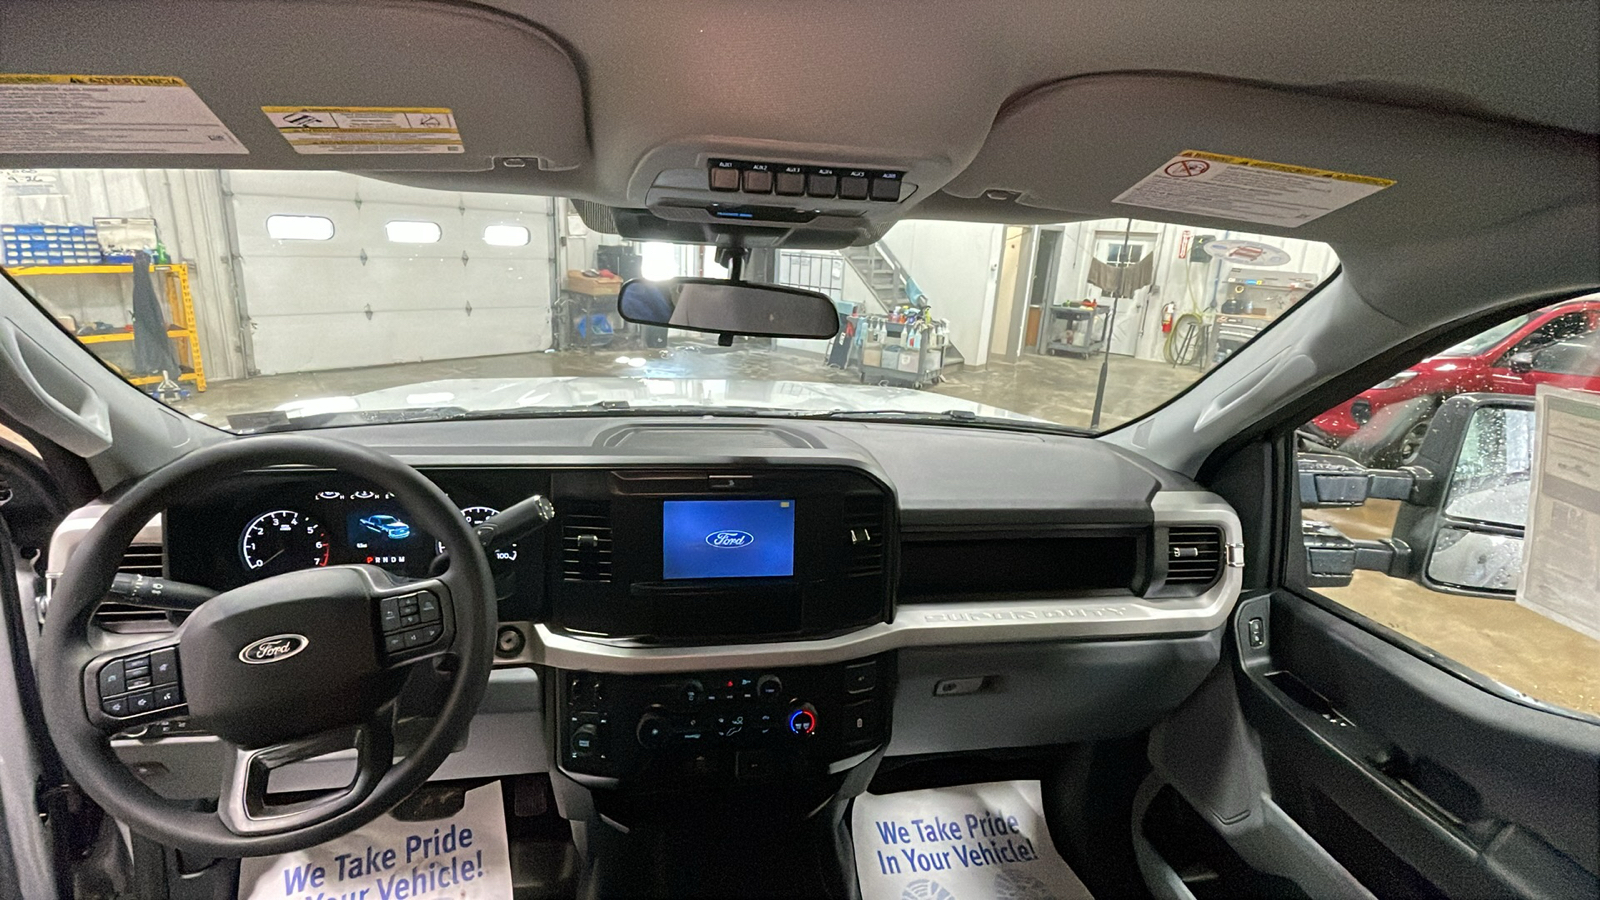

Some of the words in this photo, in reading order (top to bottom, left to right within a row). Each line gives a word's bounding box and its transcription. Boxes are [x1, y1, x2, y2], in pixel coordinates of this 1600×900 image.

[273, 518, 279, 526] 3
[714, 532, 745, 546] Ford
[256, 559, 263, 567] 0
[256, 640, 291, 658] Ford
[876, 820, 911, 845] We
[911, 817, 963, 843] Take
[965, 810, 1020, 838] Pride
[284, 863, 326, 897] We
[334, 846, 397, 882] Take
[405, 824, 473, 864] Pride
[877, 849, 901, 875] In
[902, 847, 952, 873] Your
[952, 838, 1039, 868] Vehicle!
[376, 850, 484, 900] Vehicle!
